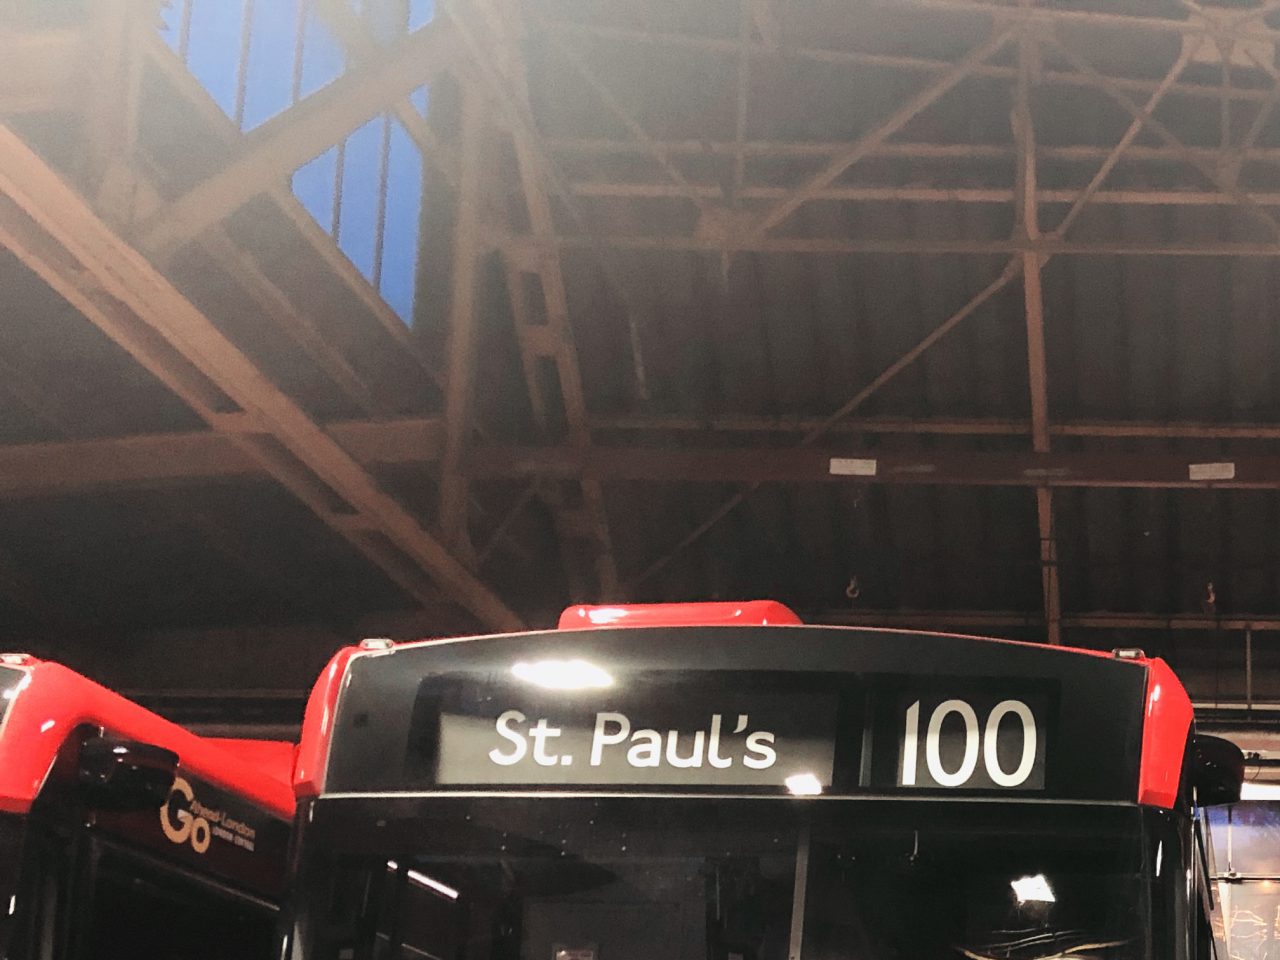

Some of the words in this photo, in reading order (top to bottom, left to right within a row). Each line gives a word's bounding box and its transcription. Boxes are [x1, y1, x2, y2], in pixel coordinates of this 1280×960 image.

[489, 709, 573, 767] St.
[590, 712, 777, 769] Paul's
[902, 700, 1037, 787] 100
